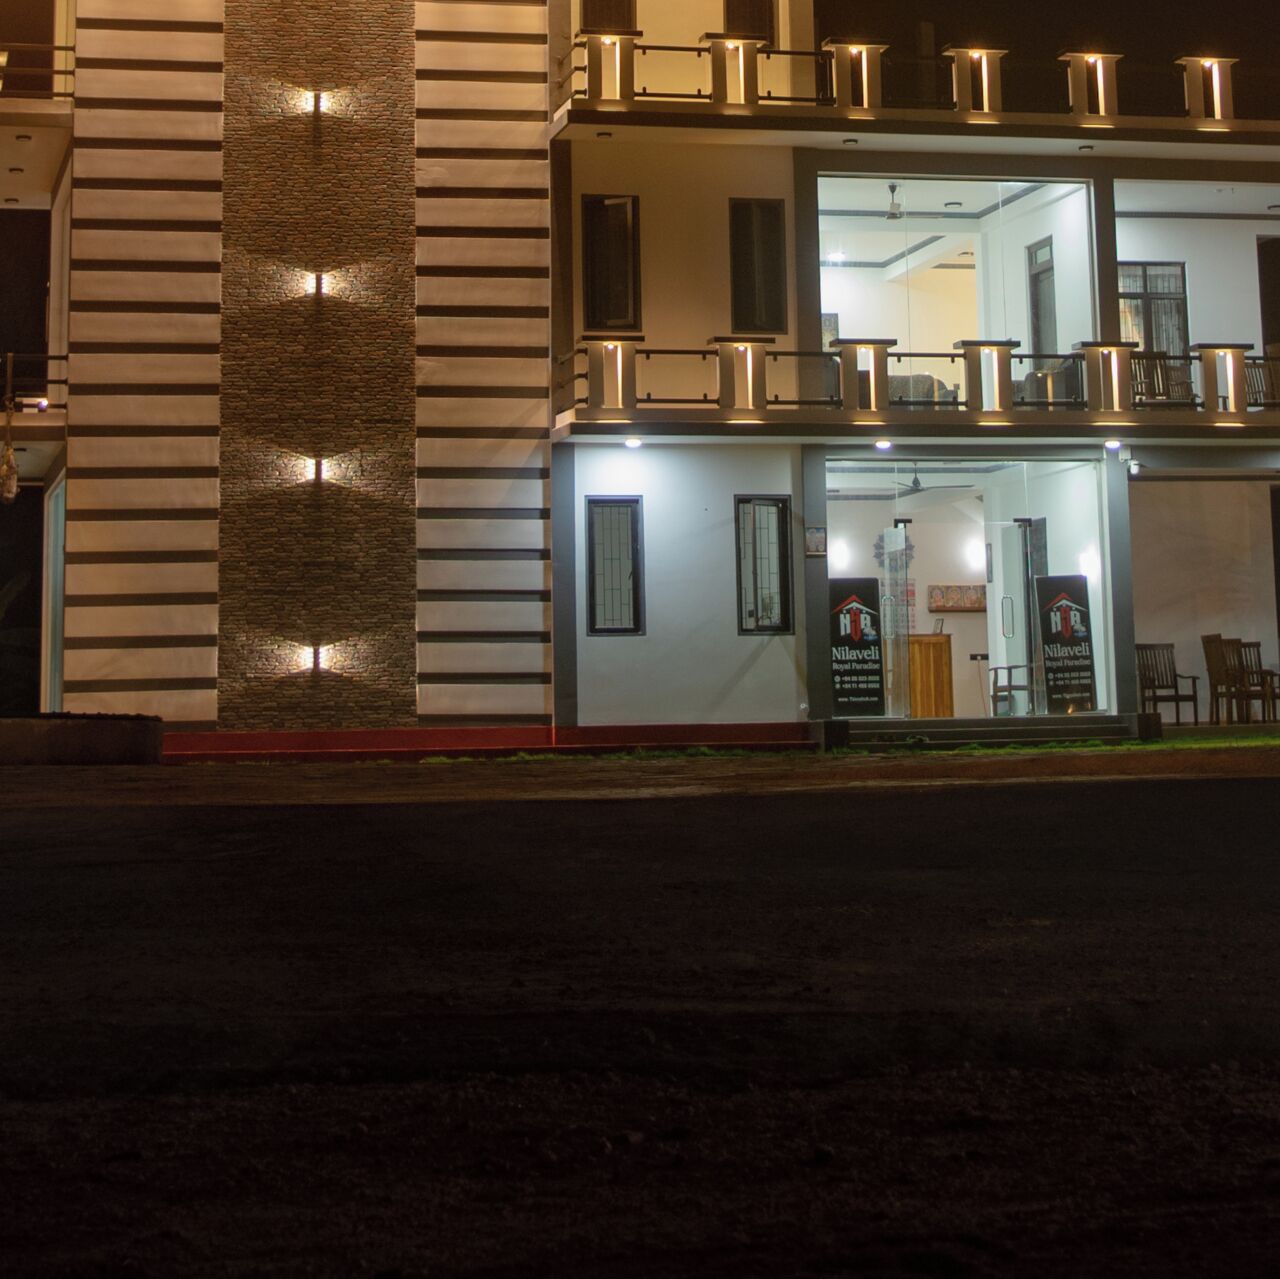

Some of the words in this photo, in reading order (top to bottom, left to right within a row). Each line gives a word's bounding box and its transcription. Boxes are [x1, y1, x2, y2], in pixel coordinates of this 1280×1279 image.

[832, 645, 880, 660] Nilaveli
[1044, 642, 1090, 658] Nilaveli
[832, 662, 851, 672] Royal
